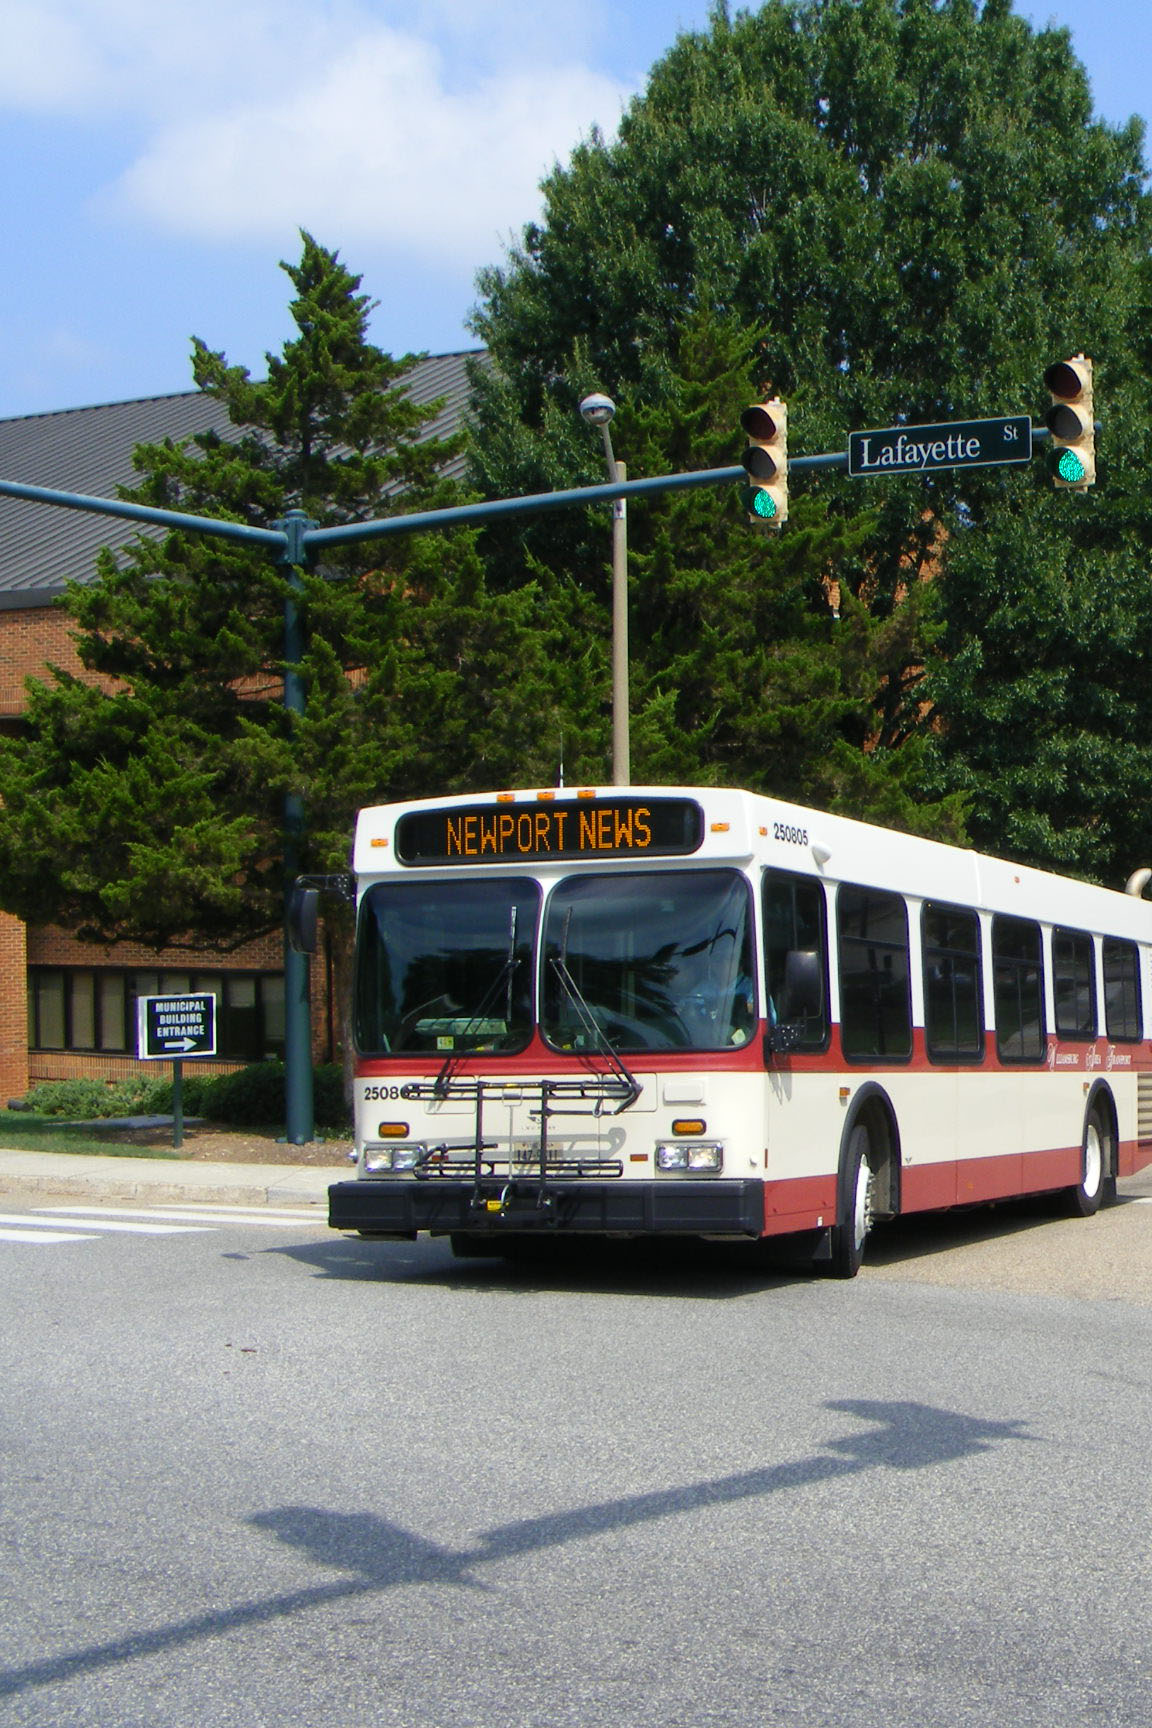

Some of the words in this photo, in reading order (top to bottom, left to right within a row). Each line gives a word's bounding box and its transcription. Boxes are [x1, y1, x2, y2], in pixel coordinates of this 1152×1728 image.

[860, 433, 980, 469] Lafayette
[1003, 425, 1018, 441] St
[447, 812, 568, 855] NEWPORT
[579, 808, 651, 850] NEWS
[774, 822, 808, 846] 250805
[155, 1001, 206, 1012] MUNICIPAL
[159, 1013, 202, 1024] BUILDING
[157, 1025, 205, 1037] ENTRANCE
[364, 1086, 418, 1100] 2508
